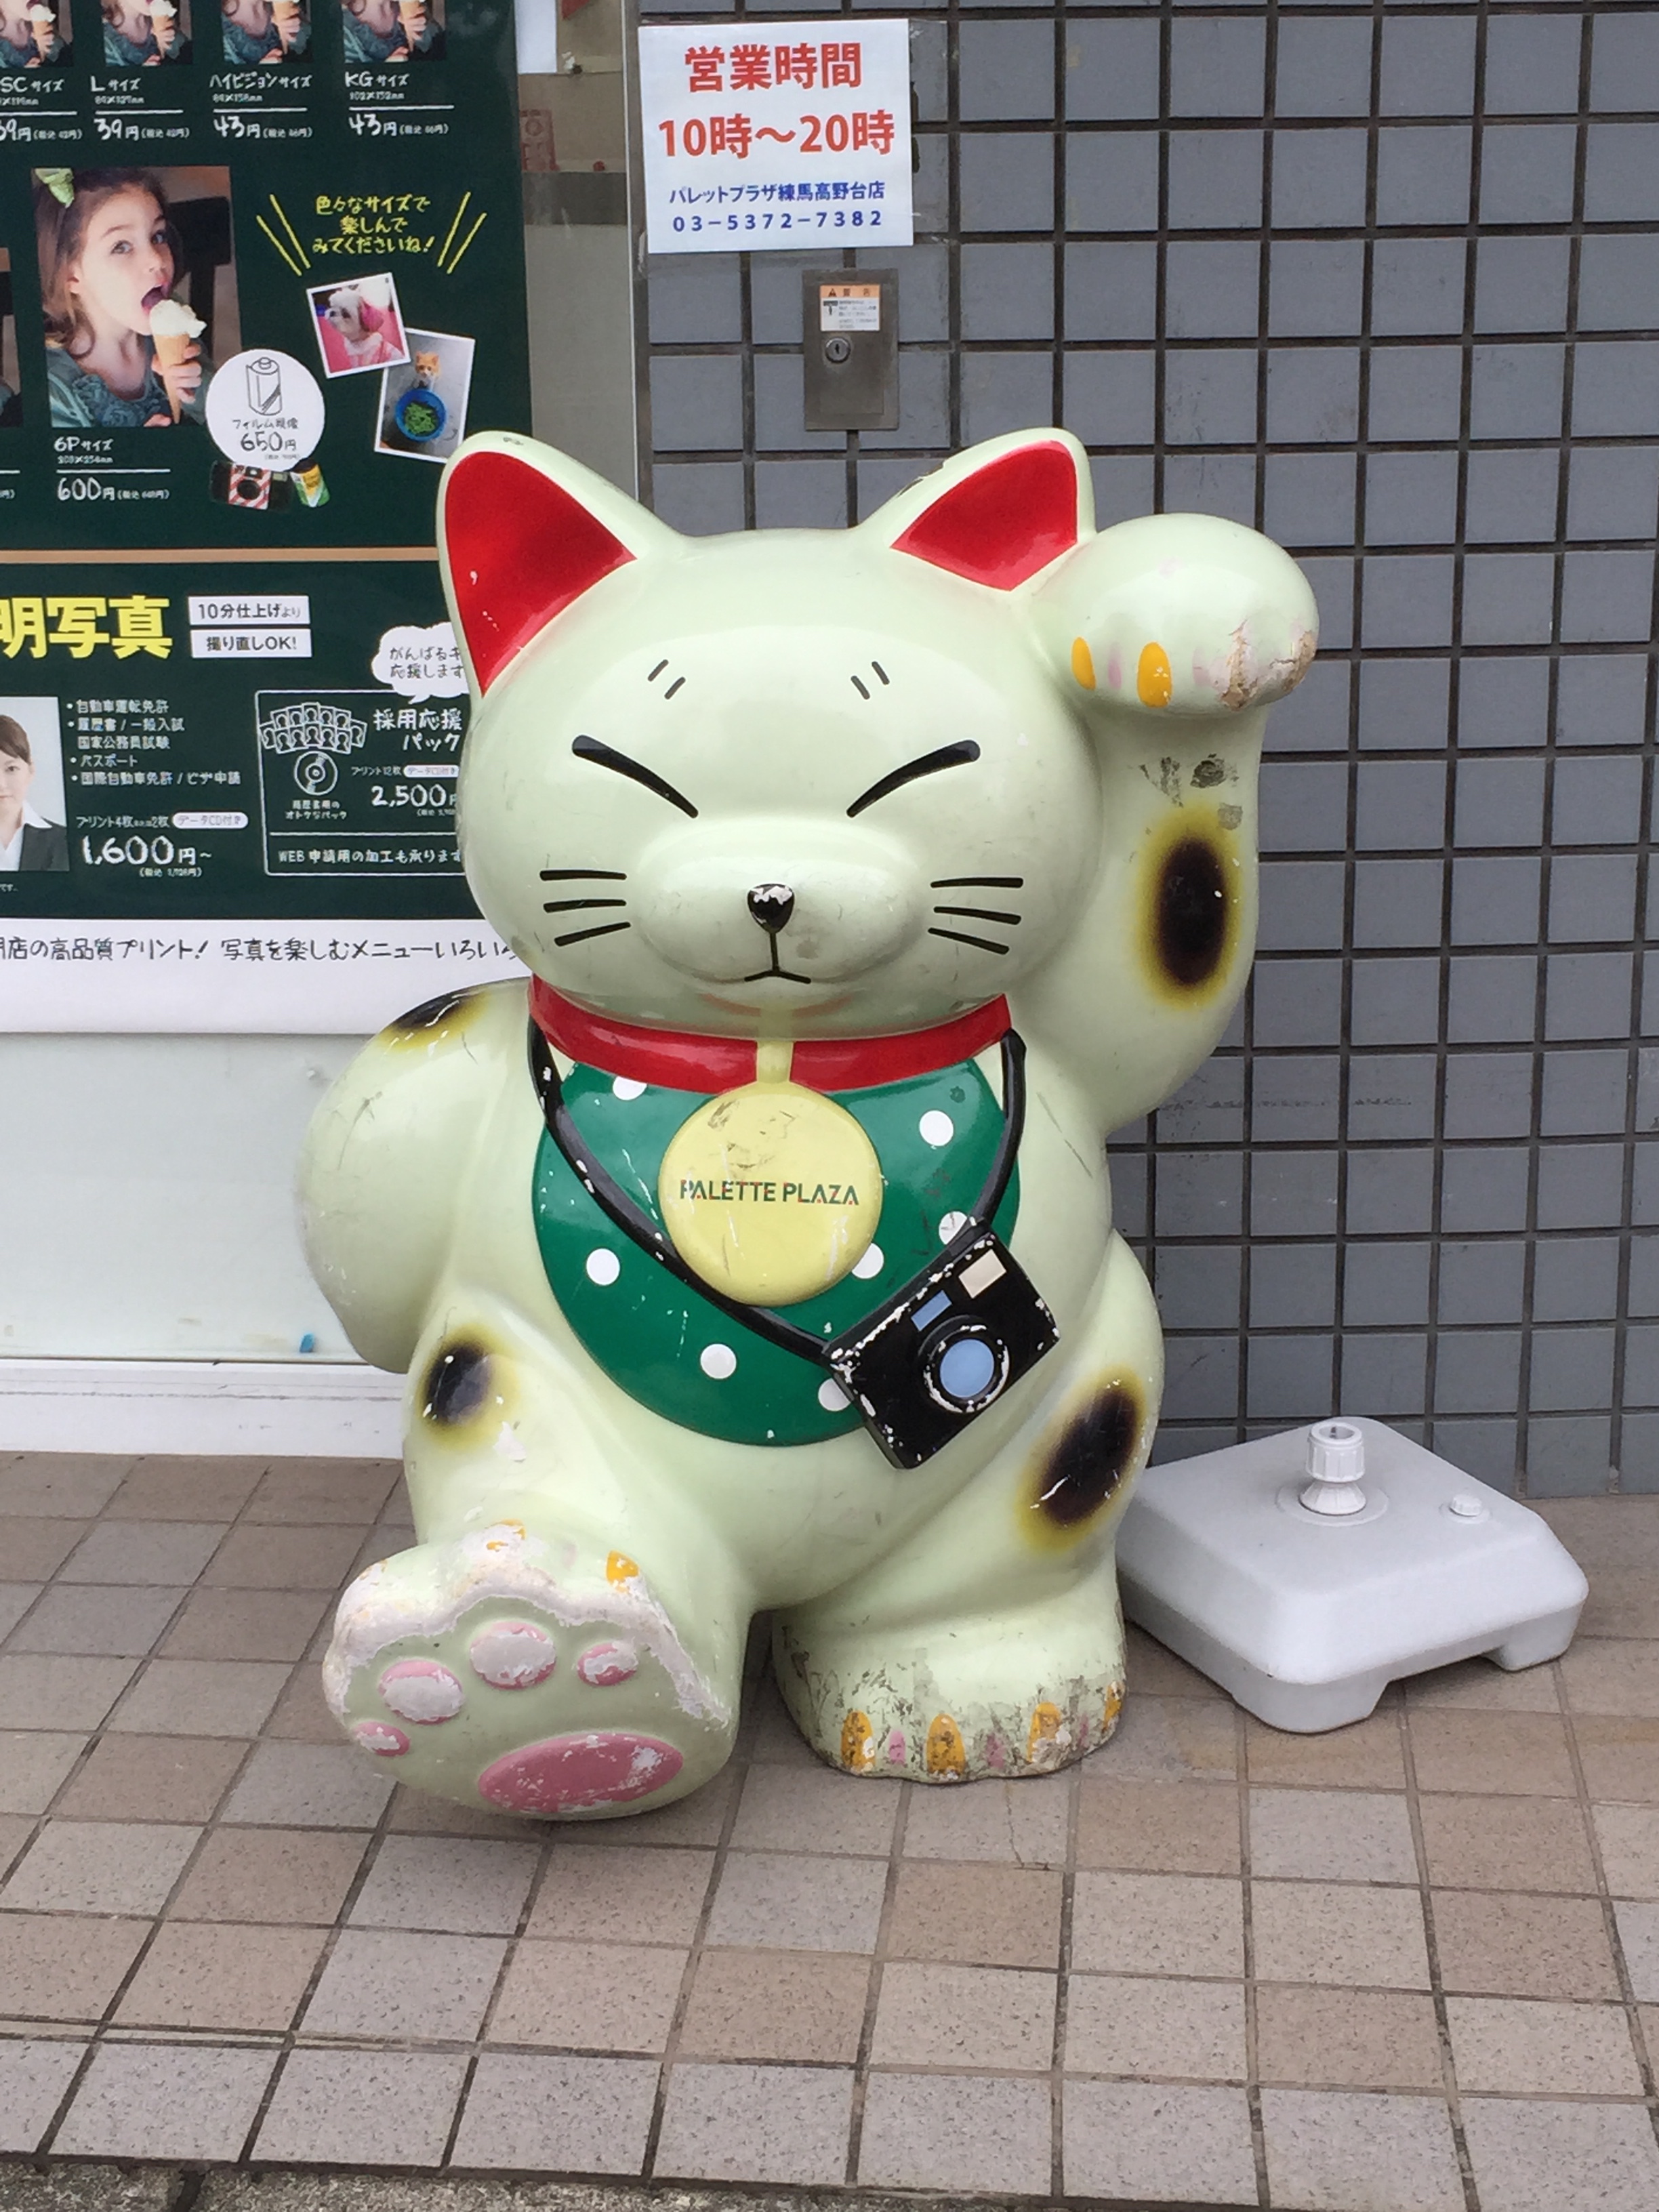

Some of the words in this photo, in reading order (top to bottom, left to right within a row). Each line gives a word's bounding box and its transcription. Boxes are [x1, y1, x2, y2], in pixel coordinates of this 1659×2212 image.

[684, 42, 861, 93] 営業時間
[209, 70, 313, 90] ハイビジョンサイズ
[213, 115, 260, 138] 43円
[348, 113, 397, 136] 43円
[659, 109, 895, 159] 10時～20時
[670, 180, 886, 204] パレットプラザ練馬高野台店
[316, 194, 431, 216] 色々なサイズで
[340, 216, 408, 235] 楽しんで
[240, 431, 297, 452] 650円
[57, 476, 115, 501] 600円
[198, 602, 302, 619] 10分仕上げより
[390, 663, 464, 678] 応援します
[76, 699, 169, 714] 自動車運転免許
[373, 708, 462, 731] 採用応援
[78, 735, 171, 750] 国家公務員試験
[403, 733, 460, 752] パック
[81, 753, 138, 768] パスポート
[278, 851, 306, 863] WEB
[680, 1179, 775, 1202] PALETTE
[782, 1182, 860, 1206] PLAZA
